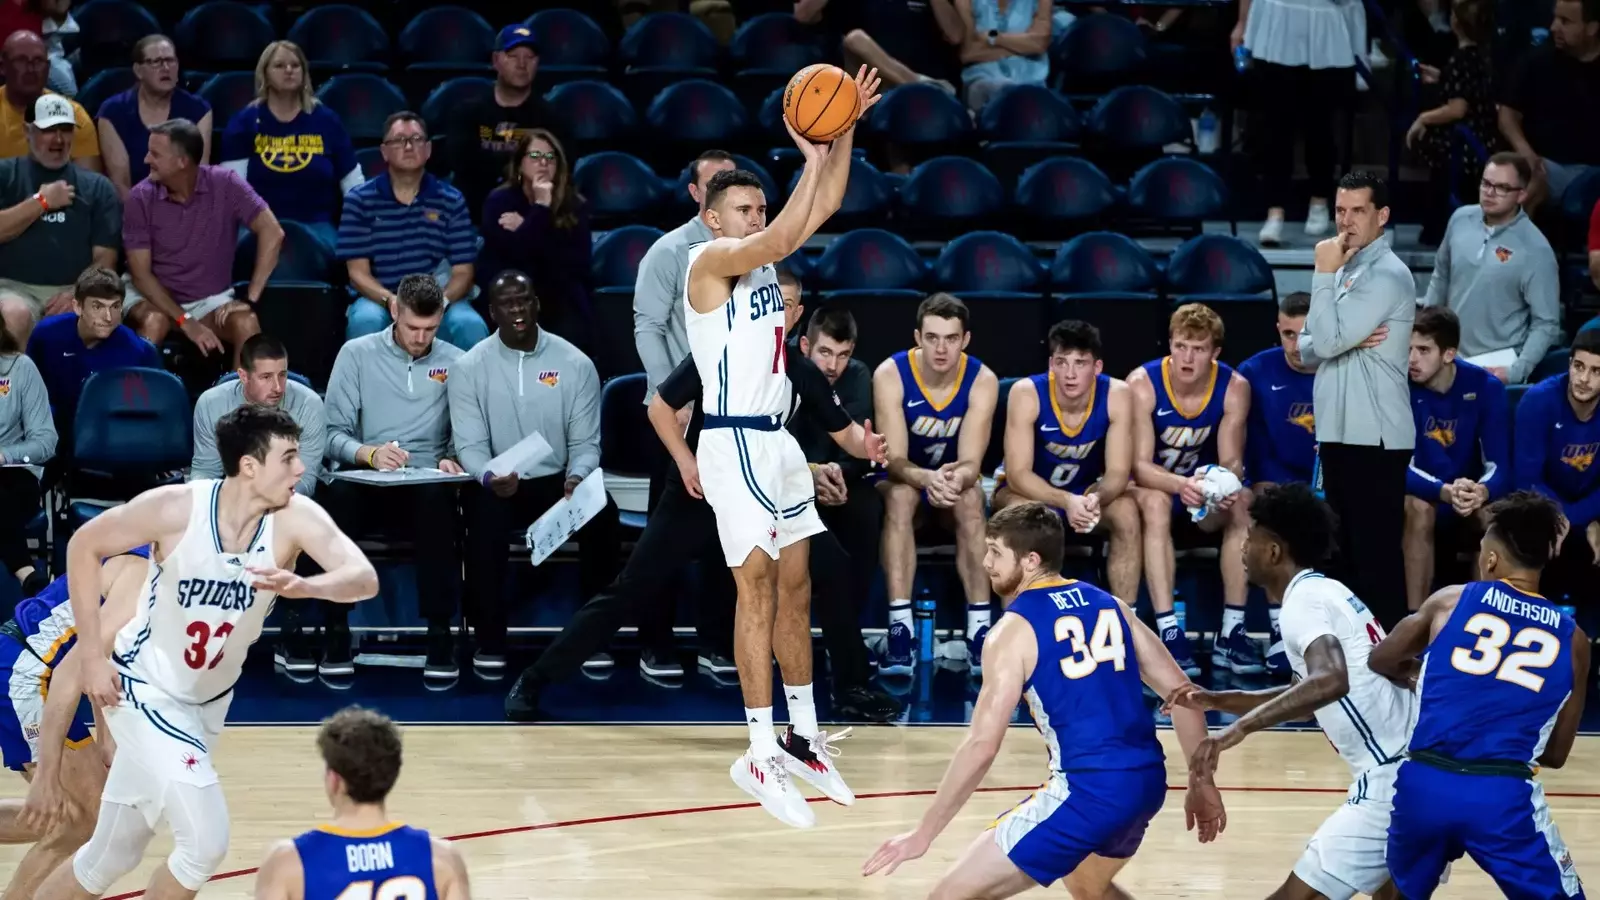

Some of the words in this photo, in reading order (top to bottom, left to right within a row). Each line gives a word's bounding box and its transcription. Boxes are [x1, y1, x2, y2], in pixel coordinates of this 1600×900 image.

[428, 368, 448, 380] UNI
[538, 371, 559, 382] UNI
[911, 415, 962, 438] UNI
[1160, 425, 1212, 448] UNI
[1045, 440, 1097, 459] UNI
[1050, 463, 1081, 487] 0
[177, 578, 258, 612] SPIDERS
[1048, 587, 1090, 610] BETZ
[1481, 587, 1561, 629] ANDERSON
[1054, 608, 1126, 680] 34
[1451, 612, 1561, 693] 32
[345, 841, 395, 873] BORN
